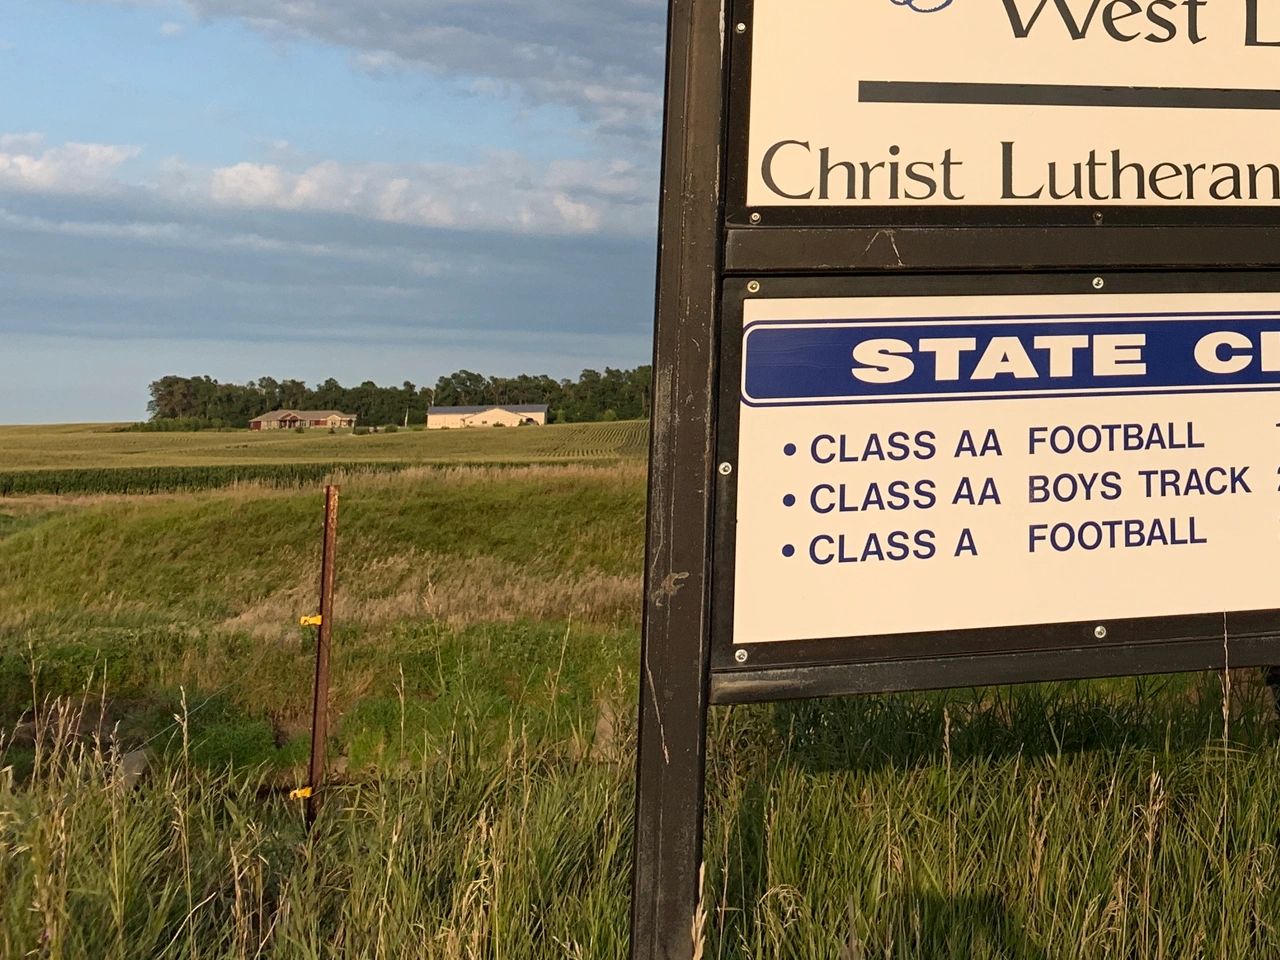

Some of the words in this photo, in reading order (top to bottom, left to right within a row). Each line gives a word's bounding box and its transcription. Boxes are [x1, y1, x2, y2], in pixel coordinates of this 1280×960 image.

[761, 140, 964, 200] Christ
[1001, 142, 1280, 200] Lutheran
[852, 334, 1146, 383] STATE
[811, 431, 936, 463] CLASS
[954, 429, 1002, 457] AA
[1029, 422, 1204, 454] FOOTBALL
[810, 480, 936, 513] CLASS
[952, 477, 1001, 505] AA
[1029, 472, 1121, 503] BOYS
[1138, 467, 1251, 497] TRACK
[809, 530, 935, 564] CLASS
[954, 528, 977, 556] A
[1029, 517, 1207, 552] FOOTBALL
